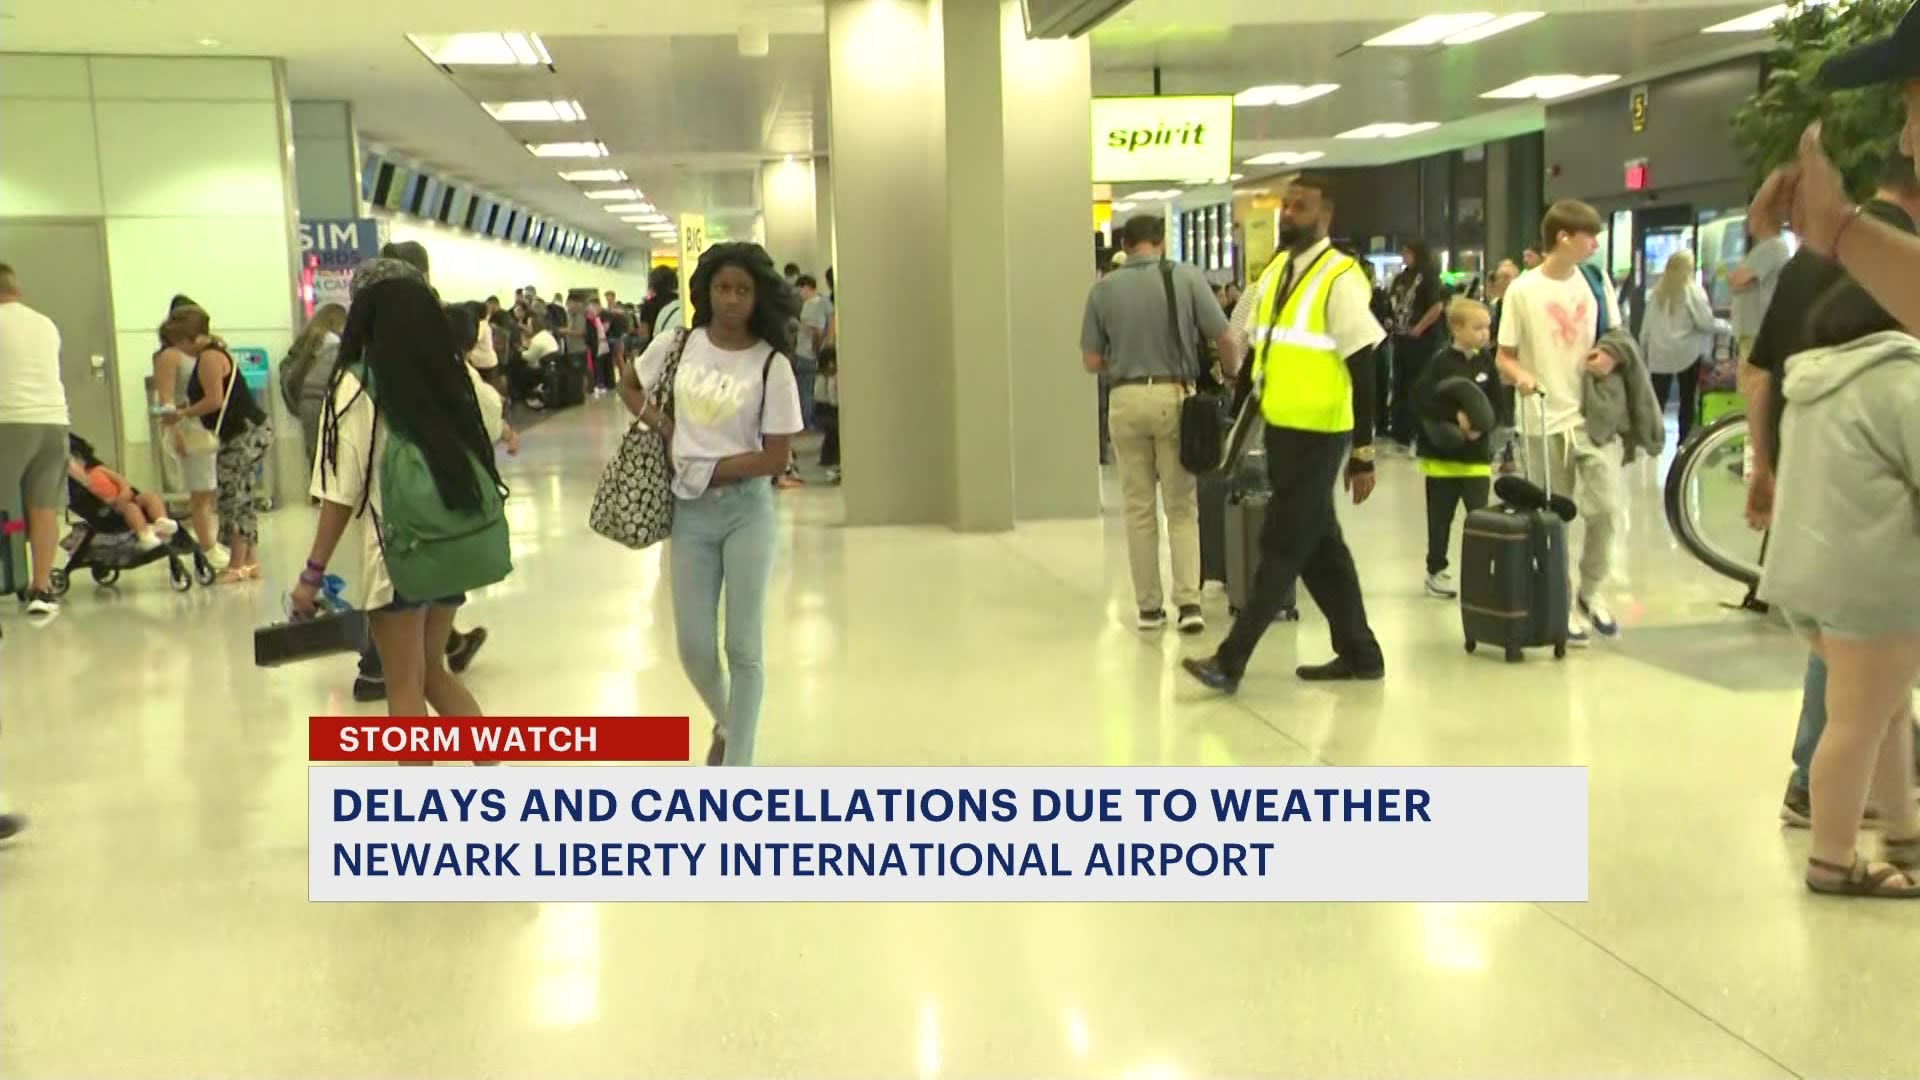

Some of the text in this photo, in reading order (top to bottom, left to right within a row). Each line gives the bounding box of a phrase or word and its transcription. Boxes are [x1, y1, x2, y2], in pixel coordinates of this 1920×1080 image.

[1108, 122, 1206, 152] spirit
[298, 222, 359, 251] SIM
[686, 226, 702, 253] BIG
